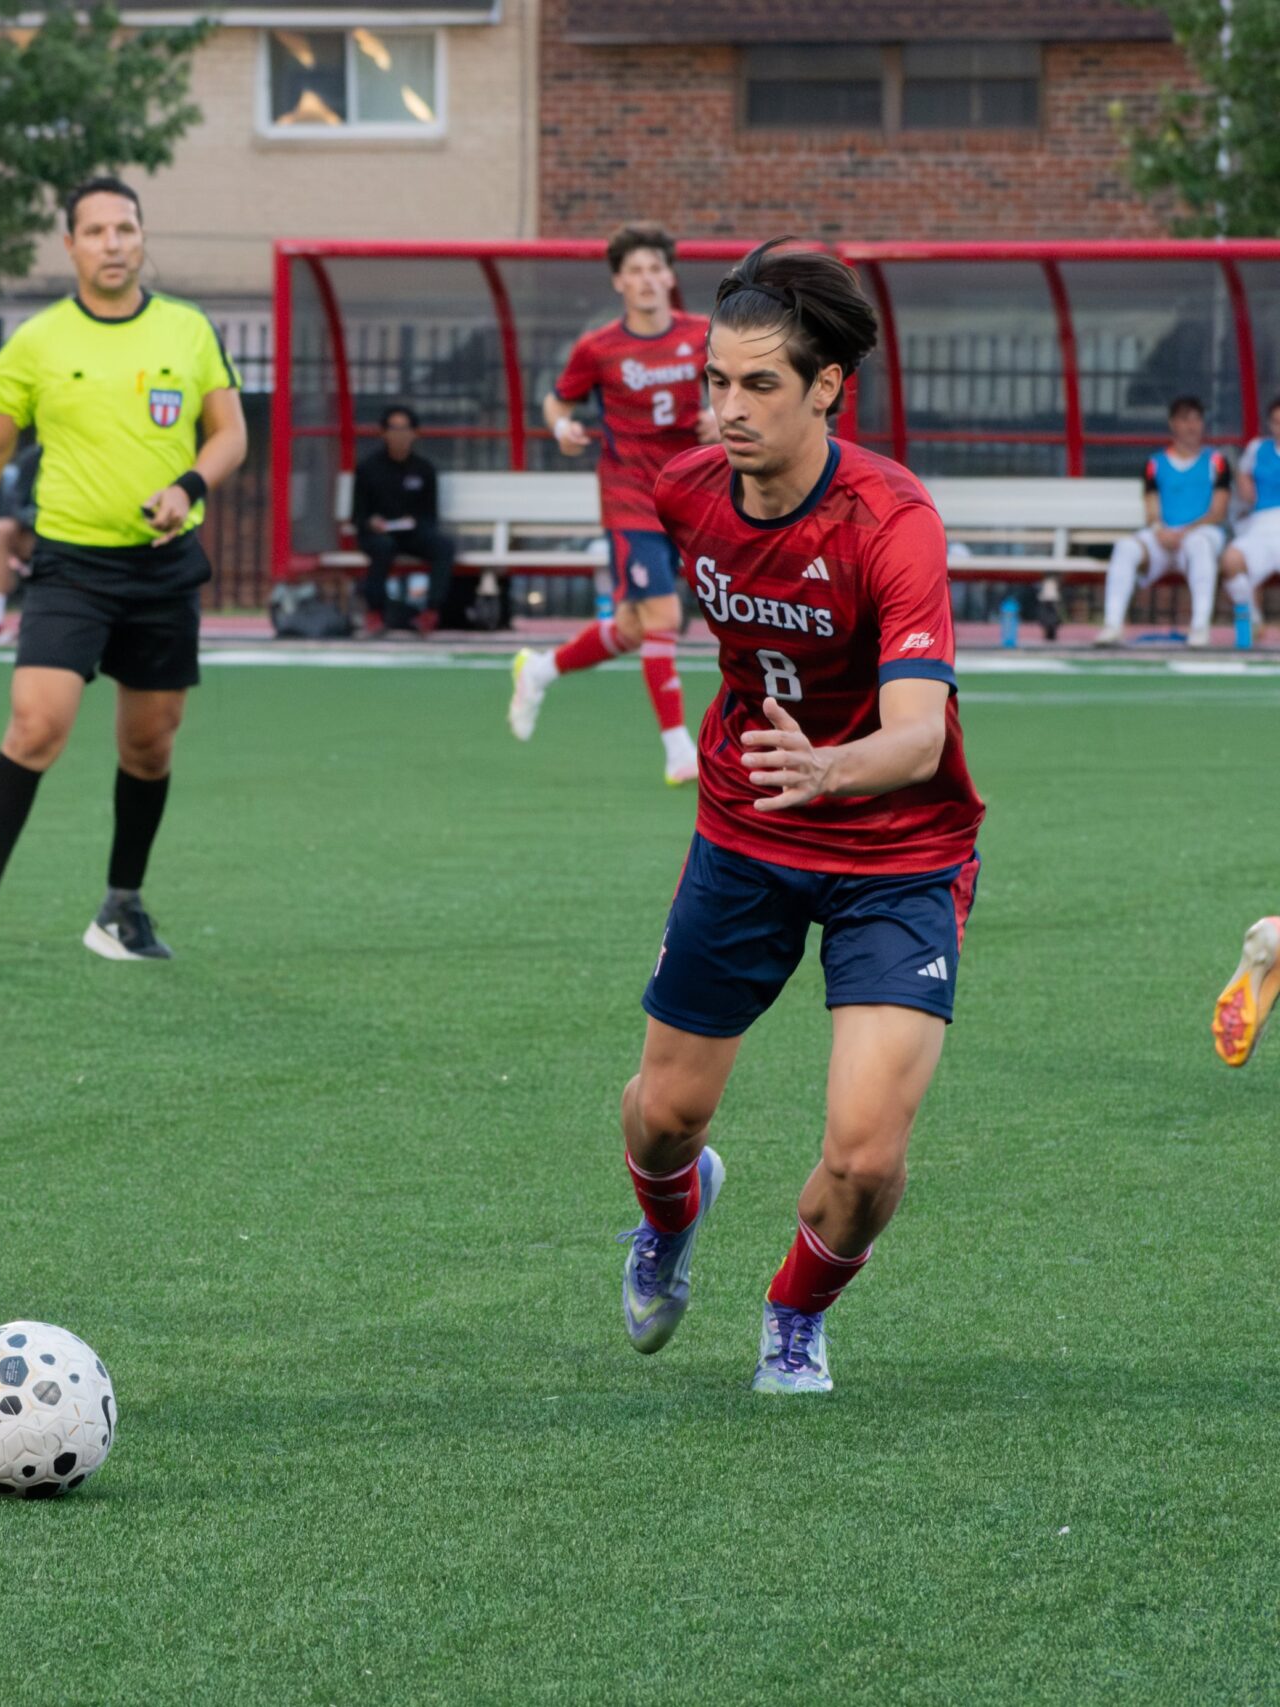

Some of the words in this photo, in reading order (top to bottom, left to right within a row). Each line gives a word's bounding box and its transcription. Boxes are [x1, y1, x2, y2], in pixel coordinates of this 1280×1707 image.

[652, 390, 676, 426] 2
[704, 590, 835, 637] JOHN'S
[755, 648, 804, 702] 8
